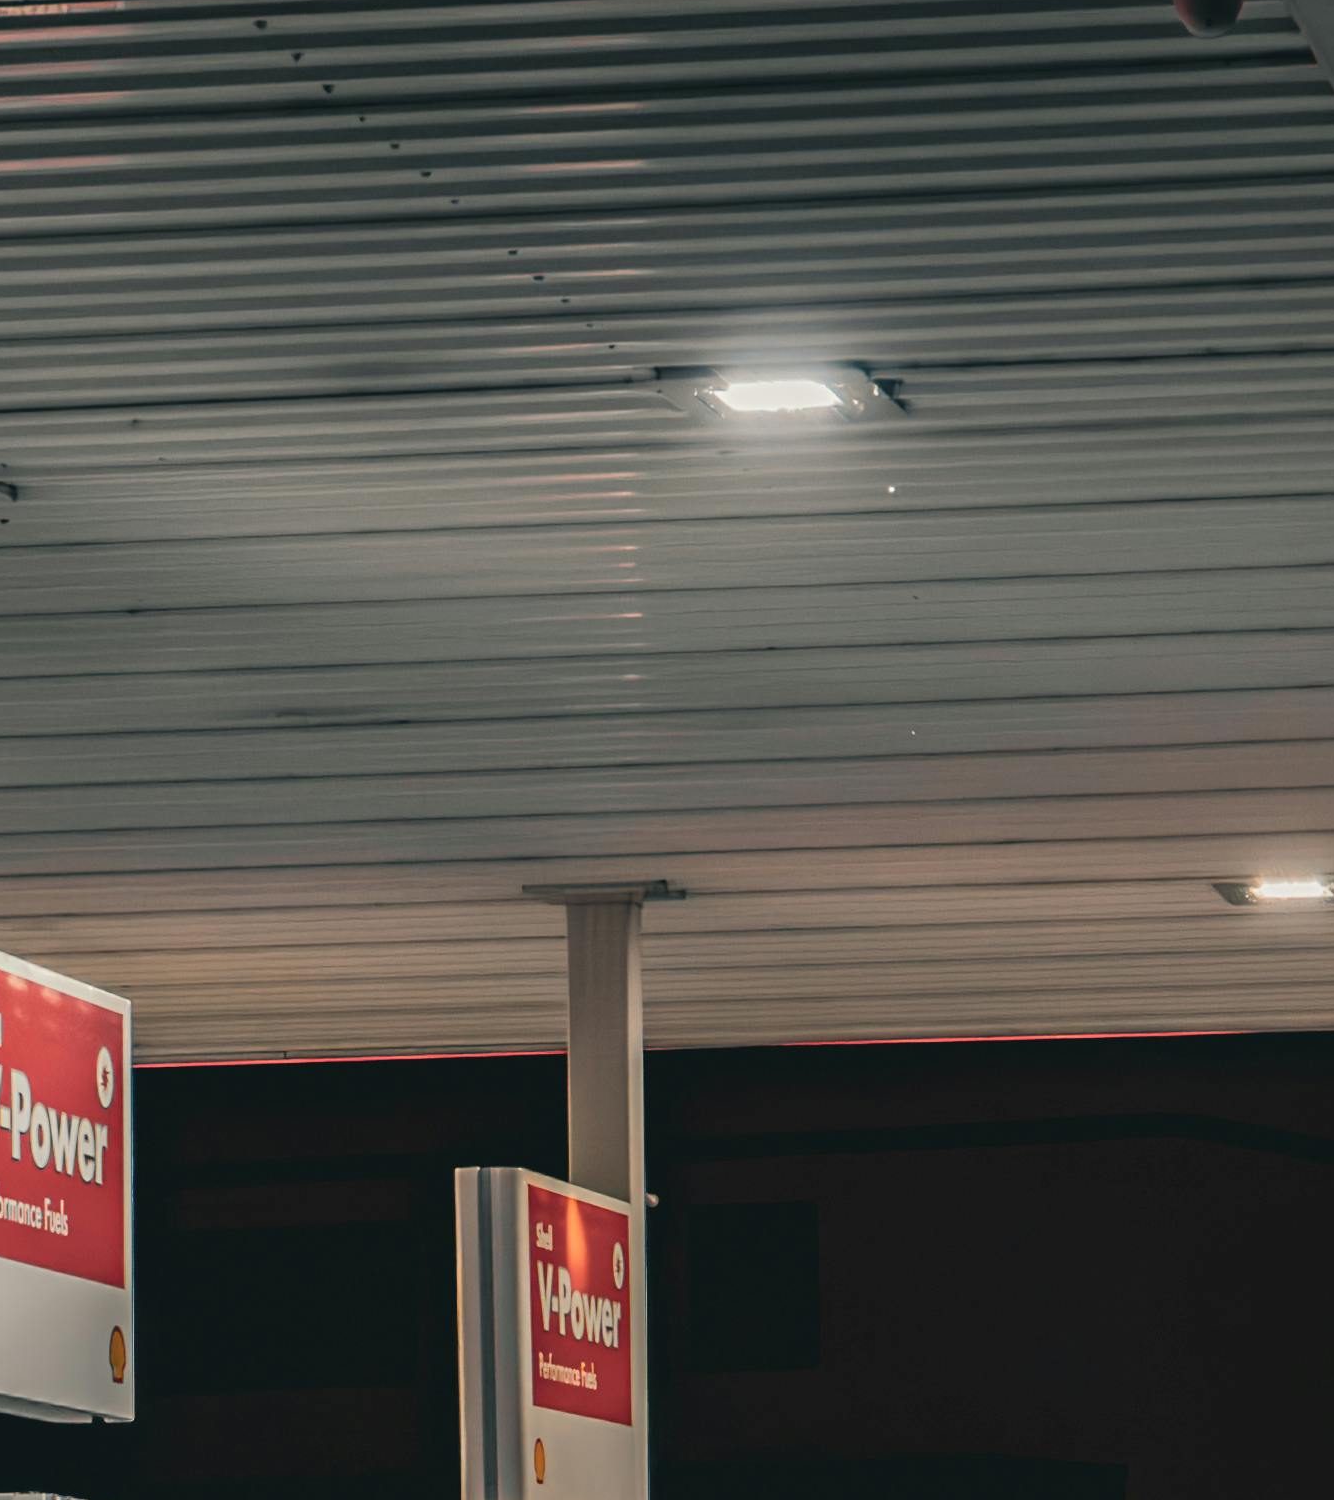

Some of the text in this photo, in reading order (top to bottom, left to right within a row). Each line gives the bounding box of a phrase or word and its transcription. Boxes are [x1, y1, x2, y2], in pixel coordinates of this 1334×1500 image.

[44, 1197, 69, 1236] Fuels
[537, 1260, 622, 1348] V-Power
[538, 1352, 581, 1387] Performance
